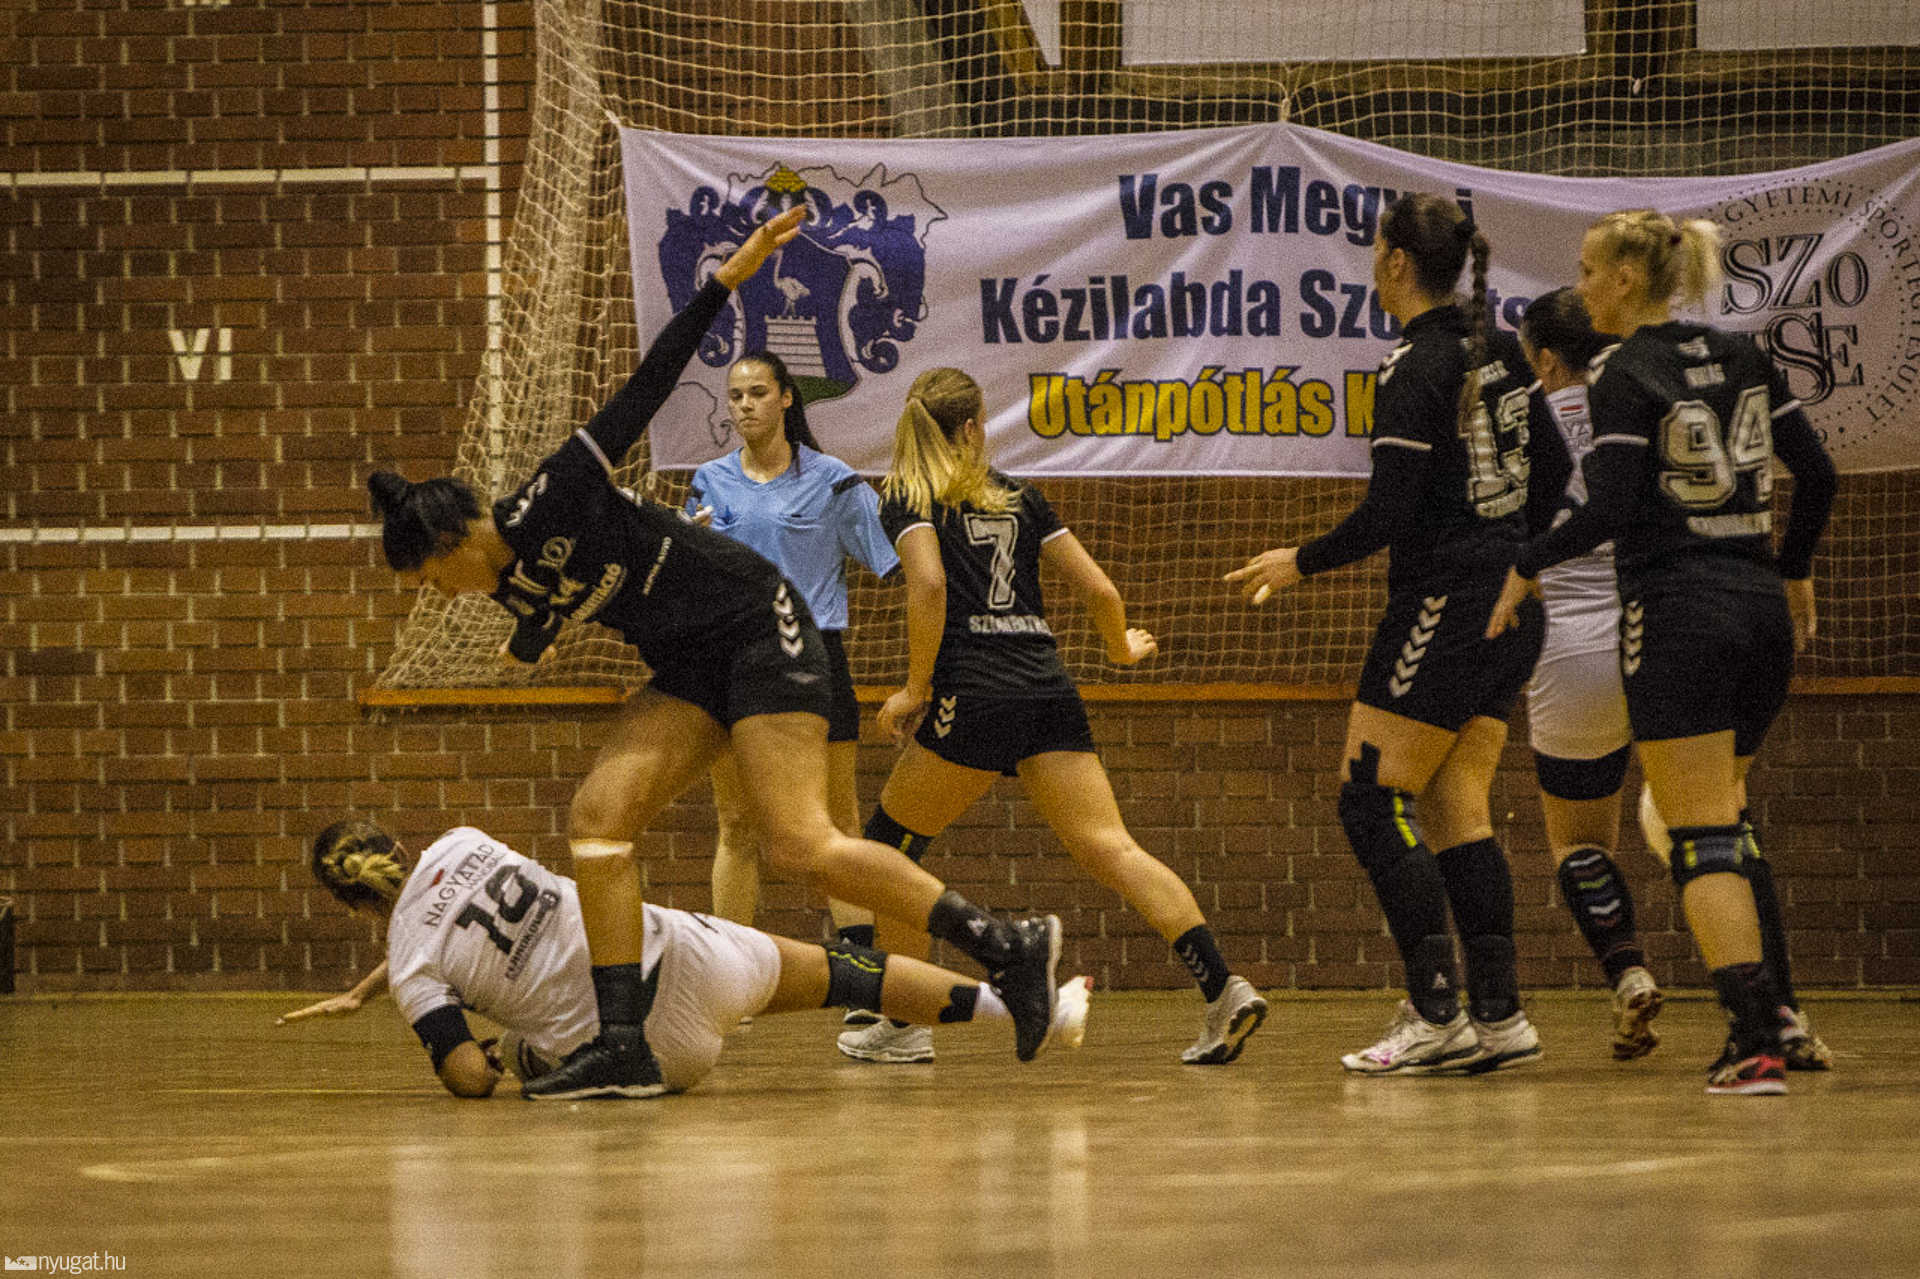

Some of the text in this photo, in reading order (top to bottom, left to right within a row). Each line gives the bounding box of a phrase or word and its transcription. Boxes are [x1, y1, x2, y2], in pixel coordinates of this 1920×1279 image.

[1118, 174, 1233, 239] Vas
[1725, 186, 1852, 222] GYETEMI
[980, 269, 1281, 344] Kézilabda
[1028, 364, 1335, 442] Utánpótlás
[1660, 385, 1773, 510] 94
[963, 513, 1018, 609] 7
